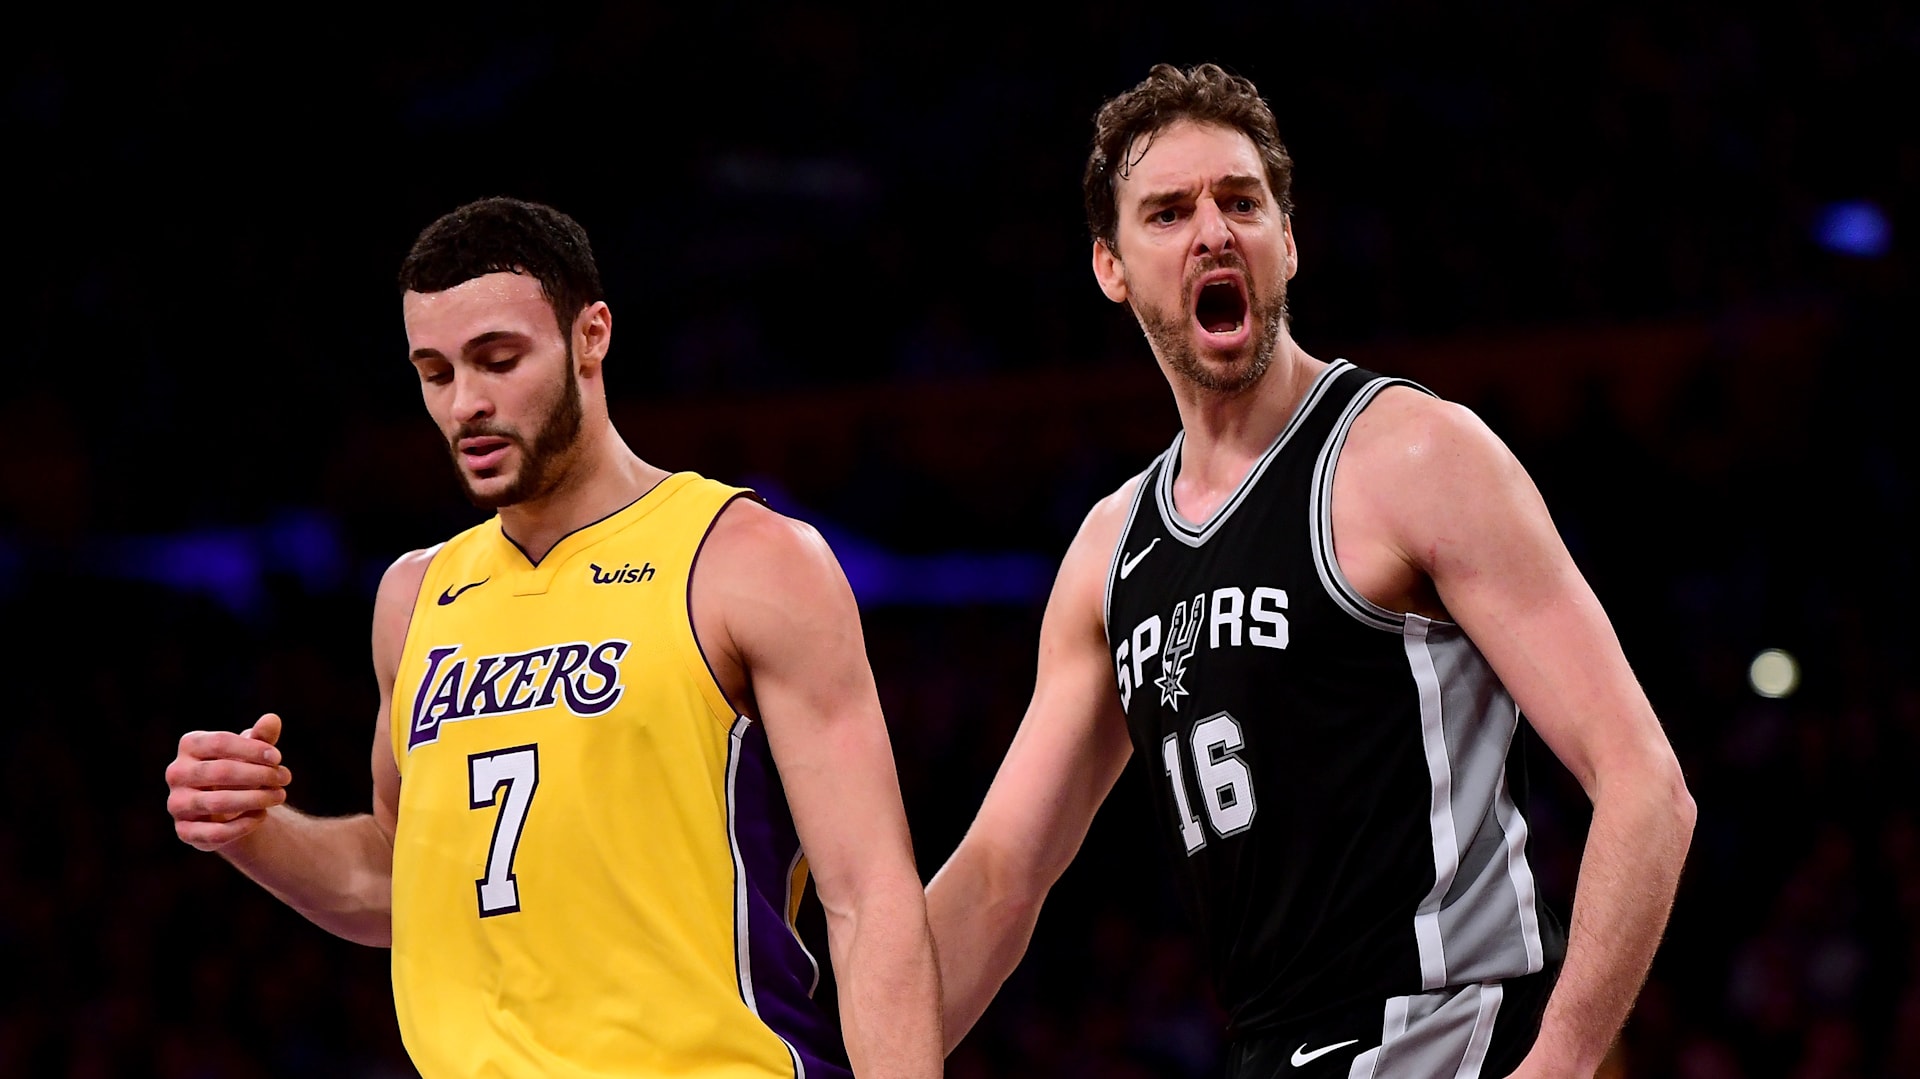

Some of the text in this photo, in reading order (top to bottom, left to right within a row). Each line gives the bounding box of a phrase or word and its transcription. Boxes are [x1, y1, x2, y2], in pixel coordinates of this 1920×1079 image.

[589, 562, 656, 584] wish
[407, 638, 632, 756] LAKERS
[1116, 586, 1290, 715] SPURS
[467, 743, 539, 919] 7
[1162, 710, 1257, 857] 16
